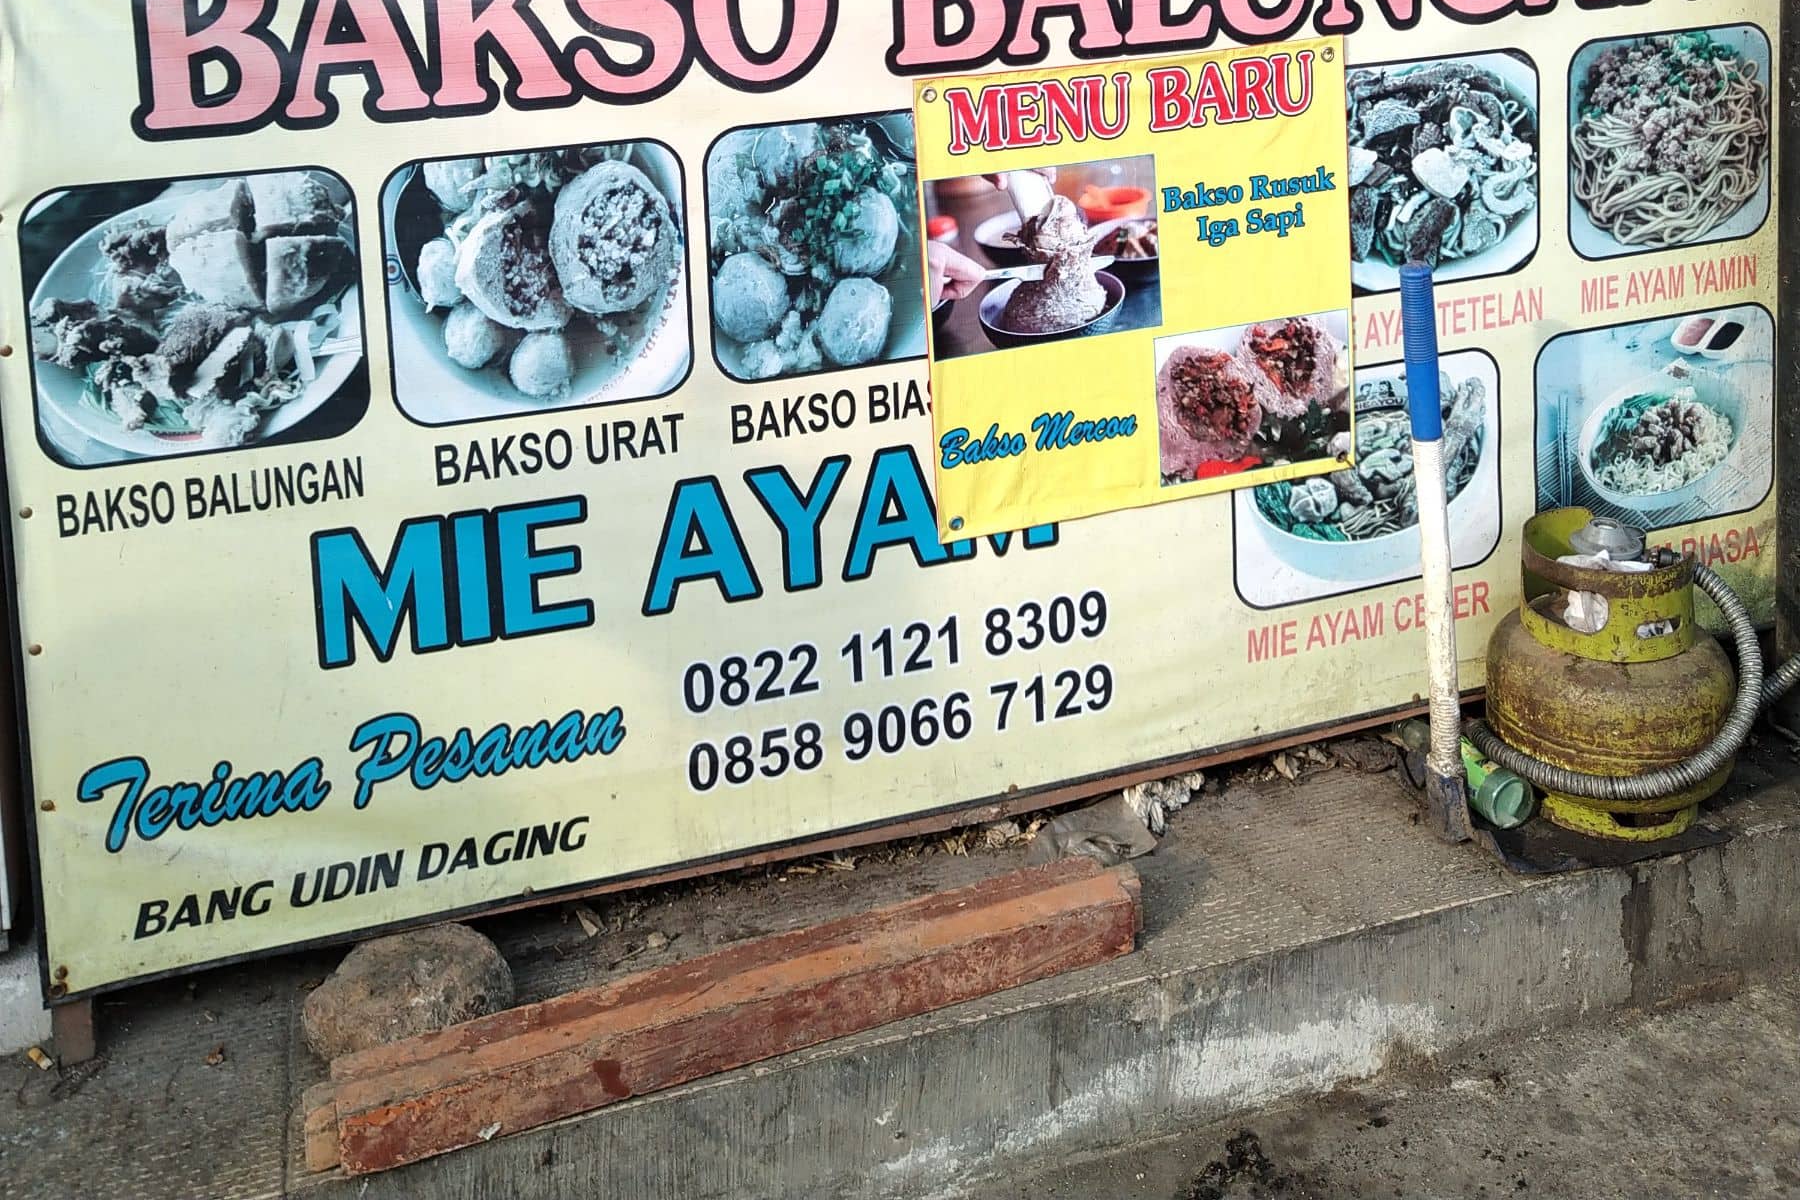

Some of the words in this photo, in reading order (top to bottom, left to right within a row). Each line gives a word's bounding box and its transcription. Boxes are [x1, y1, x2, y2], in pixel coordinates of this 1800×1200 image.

[948, 72, 1130, 155] MENU
[1149, 50, 1315, 133] BARU
[1162, 182, 1244, 213] Bakso
[1250, 167, 1336, 200] Rusuk
[1196, 215, 1240, 247] Iga
[1247, 203, 1305, 240] Sapi
[1437, 285, 1545, 337] TETELAN
[1581, 278, 1622, 314] MIE
[1624, 266, 1686, 306] AYAM
[1693, 253, 1758, 294] YAMIN
[434, 428, 573, 487] BAKSO
[586, 413, 684, 465] URAT
[730, 388, 857, 444] BAKSO
[868, 378, 933, 424] BIA
[938, 425, 1026, 470] Bakso
[1031, 411, 1138, 451] Mercon
[56, 482, 174, 538] BAKSO
[186, 456, 365, 521] BALUNGAN
[310, 492, 596, 671] MIE
[1681, 526, 1760, 568] BIASA
[683, 643, 820, 713] 0822
[840, 615, 960, 684] 1121
[983, 589, 1108, 657] 8309
[1246, 627, 1297, 663] MIE
[1306, 601, 1384, 645] AYAM
[1394, 581, 1490, 632] CEER
[688, 721, 824, 792] 0858
[842, 691, 972, 761] 9066
[989, 662, 1114, 731] 7129
[76, 755, 331, 853] Terima
[348, 706, 627, 810] Pesanan
[133, 879, 275, 940] BANG
[288, 847, 404, 908] UDIN
[416, 815, 590, 881] DAGING
